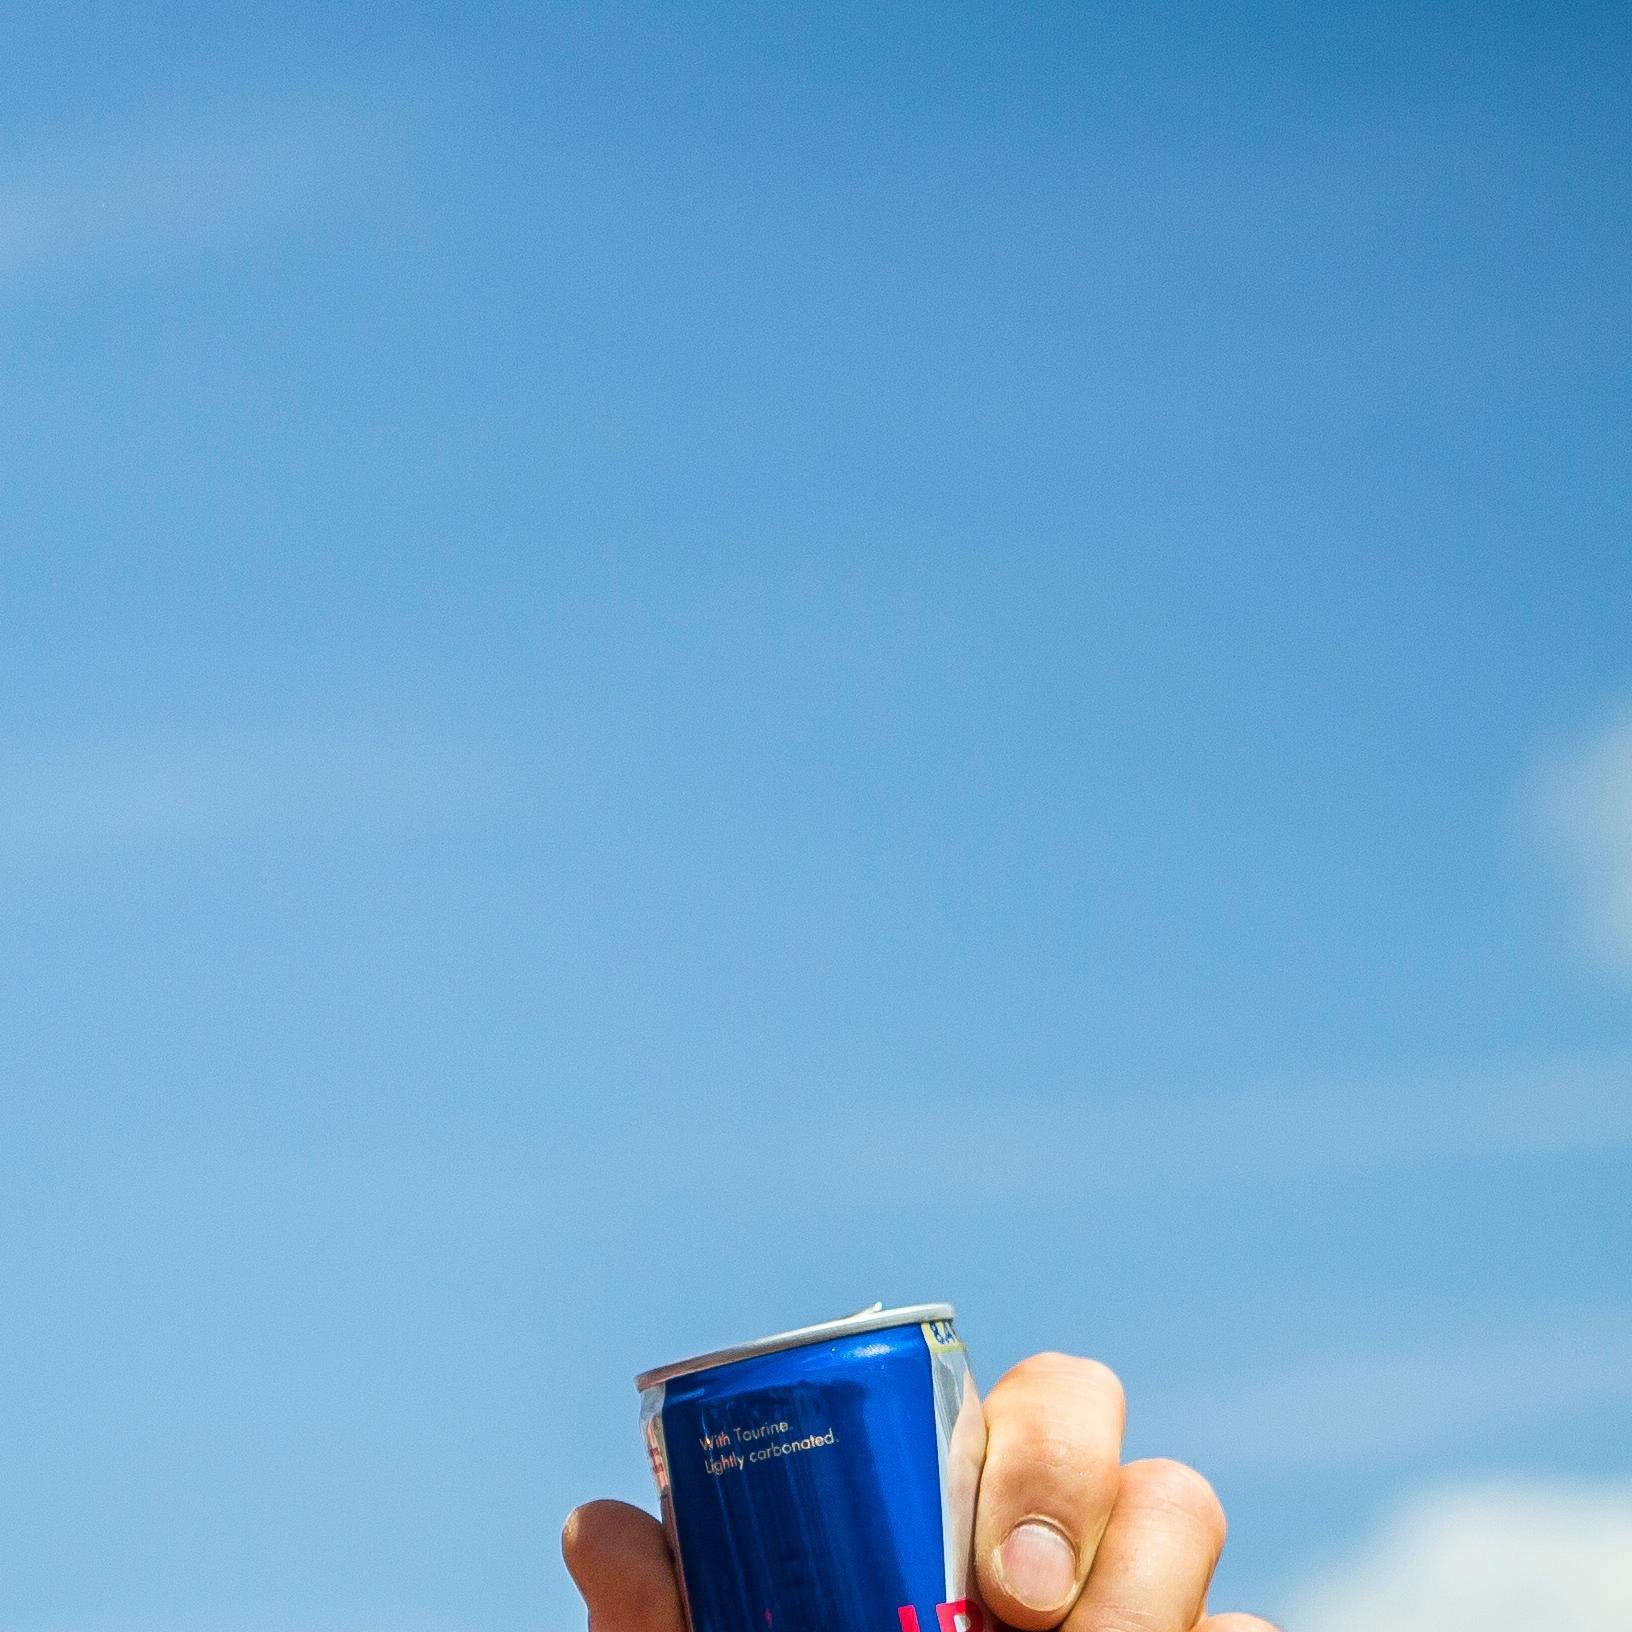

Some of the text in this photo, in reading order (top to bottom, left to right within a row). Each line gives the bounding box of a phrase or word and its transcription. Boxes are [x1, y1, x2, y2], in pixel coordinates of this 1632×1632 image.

[699, 1430, 731, 1451] With
[704, 1427, 840, 1475] Lightly carbonated.
